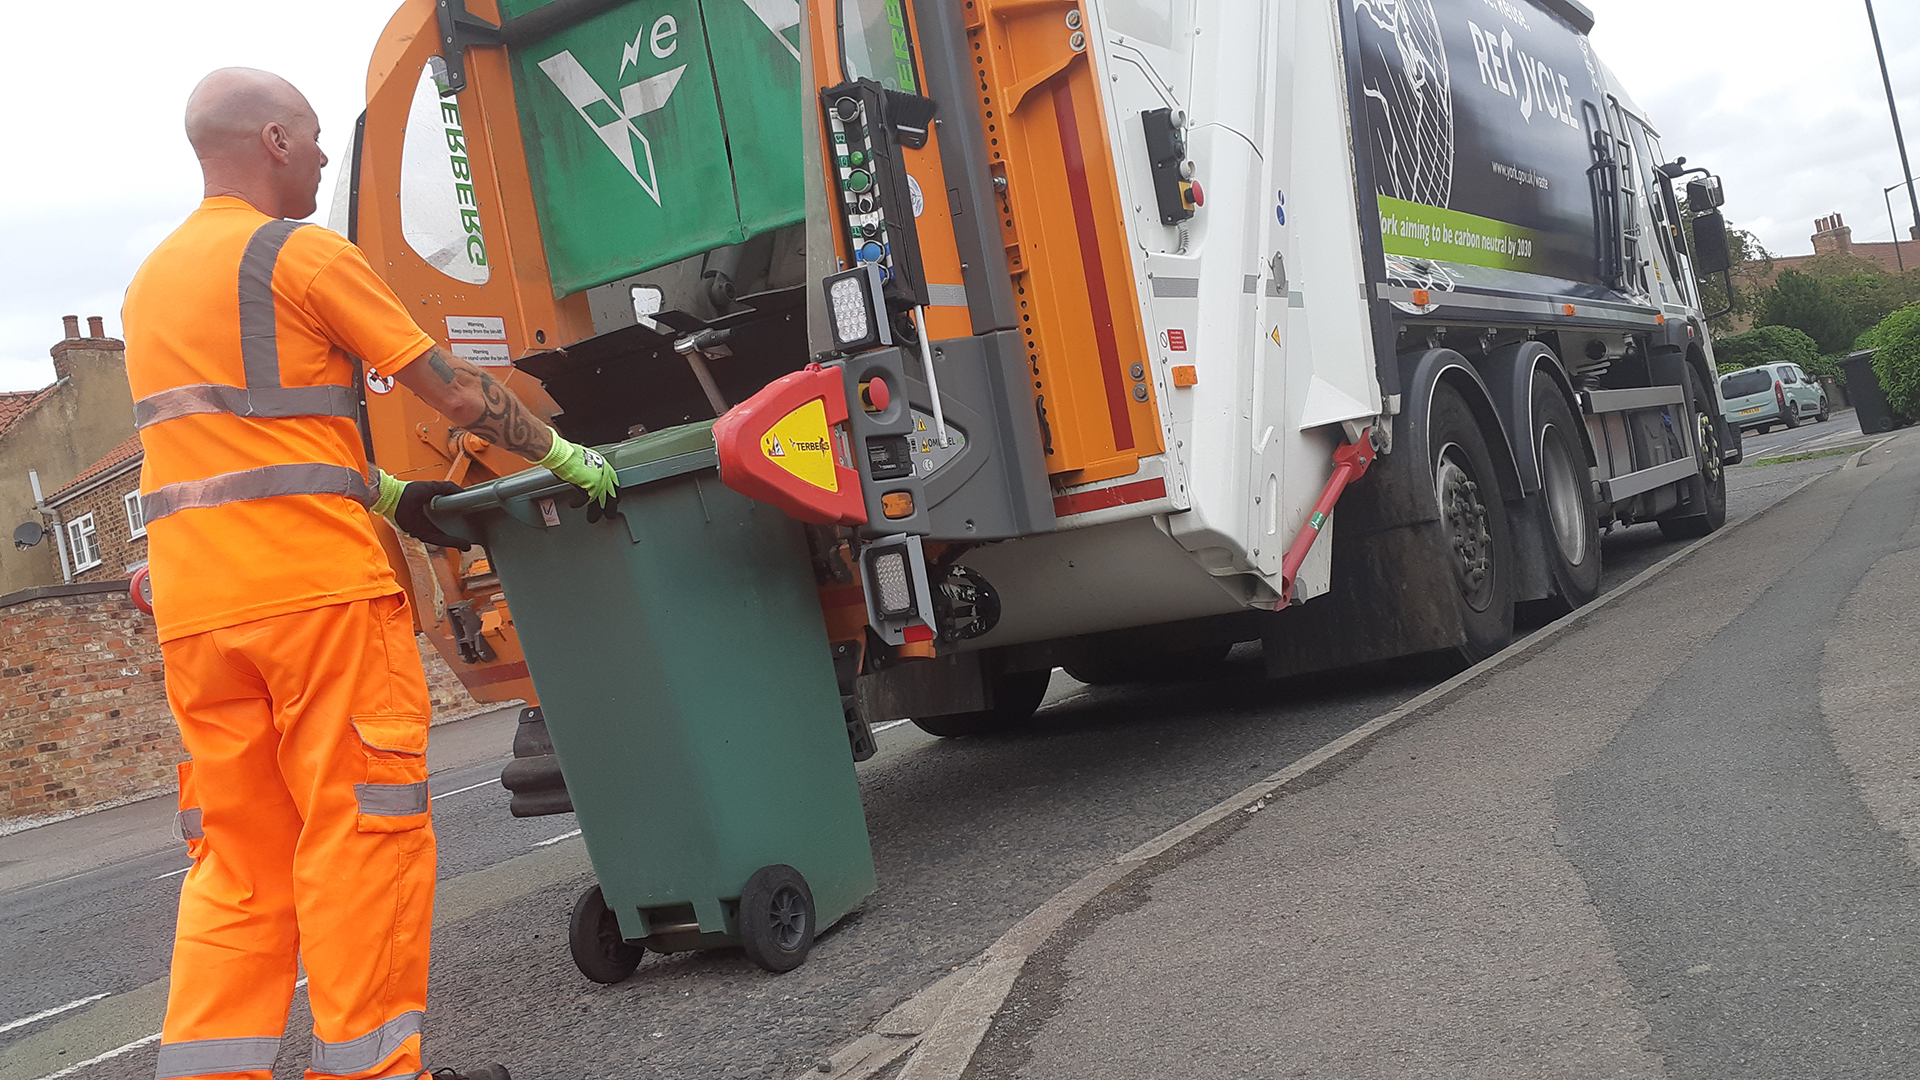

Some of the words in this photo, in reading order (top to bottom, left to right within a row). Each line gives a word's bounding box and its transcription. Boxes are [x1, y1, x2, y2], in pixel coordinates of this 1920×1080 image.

[1467, 20, 1579, 129] RECYCLE
[1491, 161, 1549, 190] www.york.gov.uk/waste
[1400, 216, 1430, 247] aiming
[1432, 223, 1441, 242] to
[1443, 223, 1453, 244] be
[1455, 228, 1481, 249] carbon
[1482, 235, 1507, 255] neutral
[1508, 236, 1517, 261] by
[1517, 238, 1532, 258] 2030
